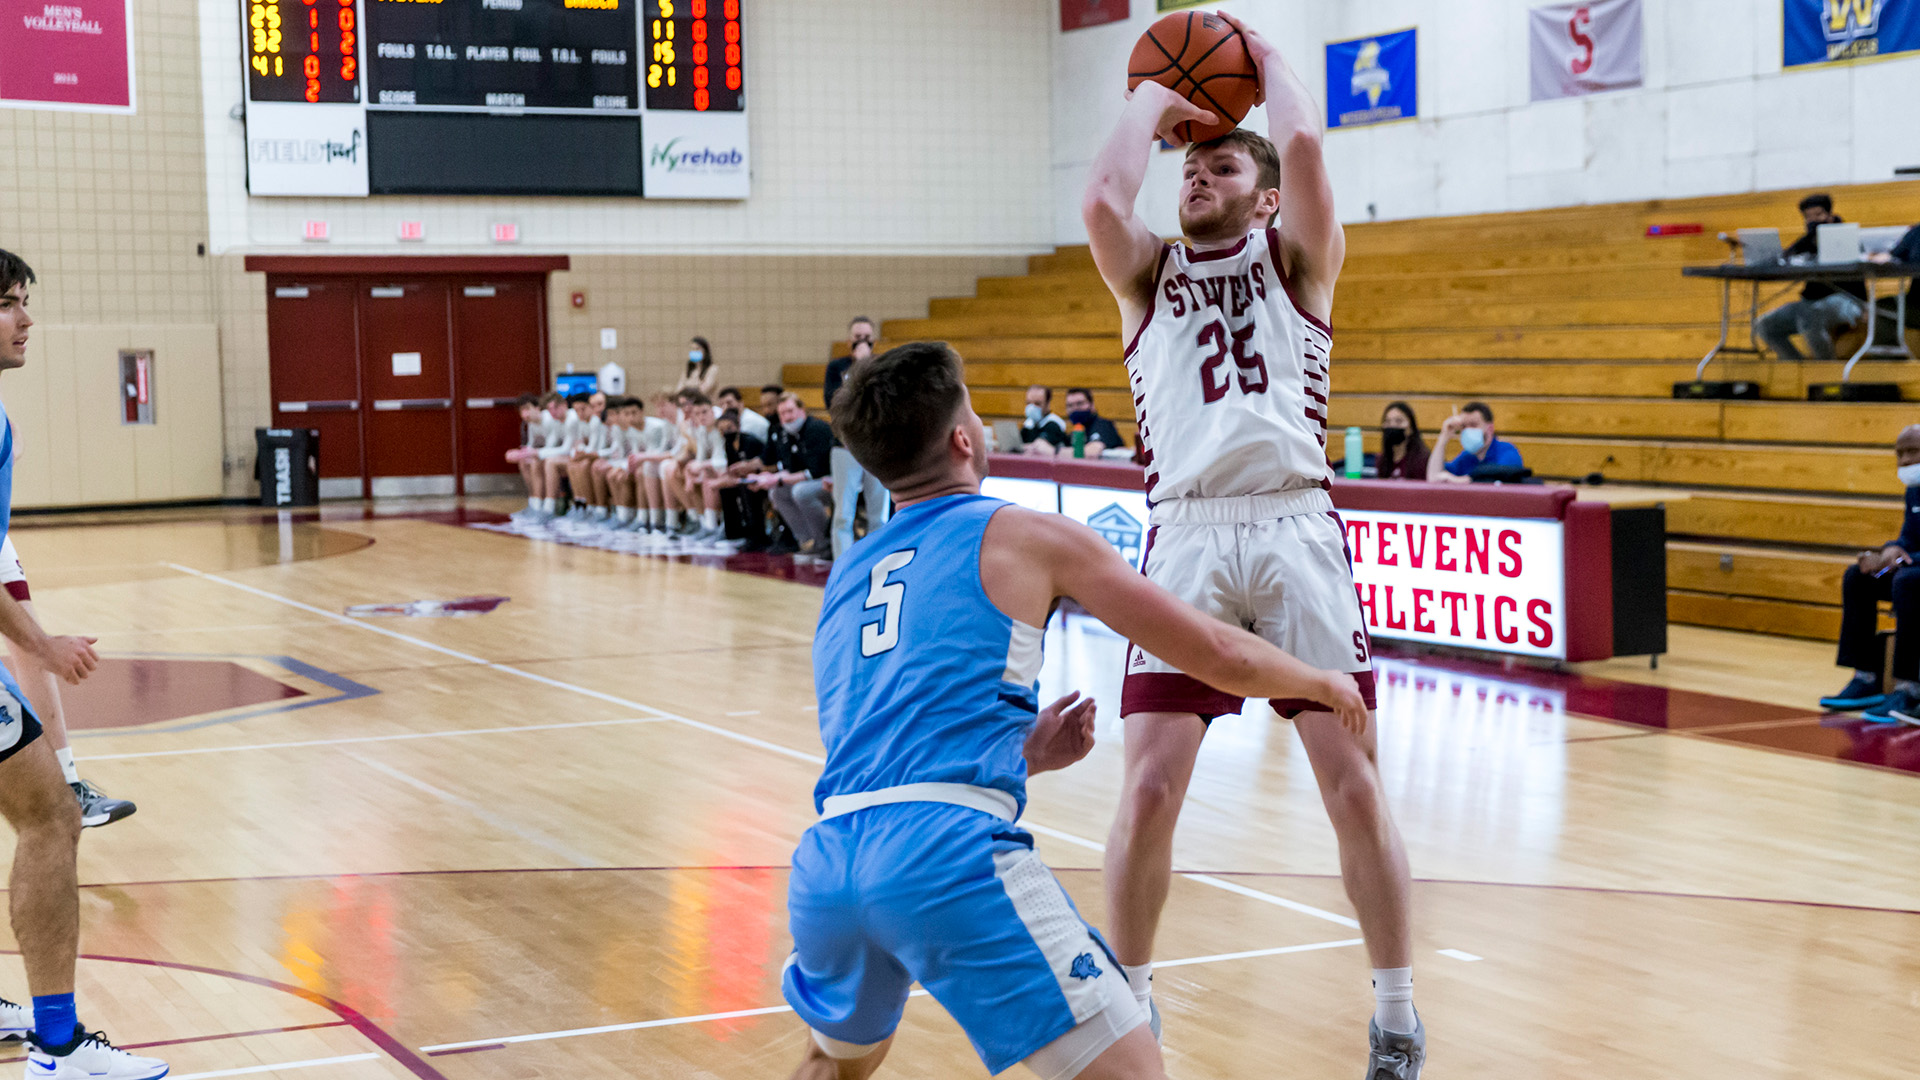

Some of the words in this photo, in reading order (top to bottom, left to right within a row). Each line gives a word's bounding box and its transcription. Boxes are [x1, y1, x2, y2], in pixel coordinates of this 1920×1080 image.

[23, 16, 103, 34] VOLLEYBALL
[250, 4, 281, 29] 25
[309, 8, 318, 29] 1
[338, 7, 354, 31] 0
[253, 28, 282, 53] 32
[311, 31, 319, 52] 1
[340, 31, 355, 55] 2
[653, 19, 675, 40] 11
[692, 19, 707, 43] 0
[724, 21, 740, 44] 0
[1569, 7, 1593, 74] S
[378, 43, 415, 59] FOULS
[466, 46, 509, 61] PLAYER
[513, 47, 542, 62] FOUL
[591, 49, 628, 65] FOULS
[653, 40, 675, 64] 15
[692, 42, 708, 66] 0
[725, 43, 740, 66] 0
[252, 55, 283, 77] 41
[304, 54, 320, 79] 0
[341, 56, 356, 81] 2
[647, 64, 676, 88] 21
[693, 65, 709, 89] 0
[725, 66, 741, 90] 0
[305, 78, 320, 103] 2
[379, 90, 416, 105] SCORE
[593, 95, 628, 109] SCORE
[693, 88, 709, 111] 0
[1196, 318, 1269, 406] 25
[275, 448, 292, 505] TRASH
[1346, 520, 1523, 578] TEVENS
[861, 547, 918, 659] 5
[1354, 582, 1553, 648] HLETICS
[1353, 630, 1367, 663] S
